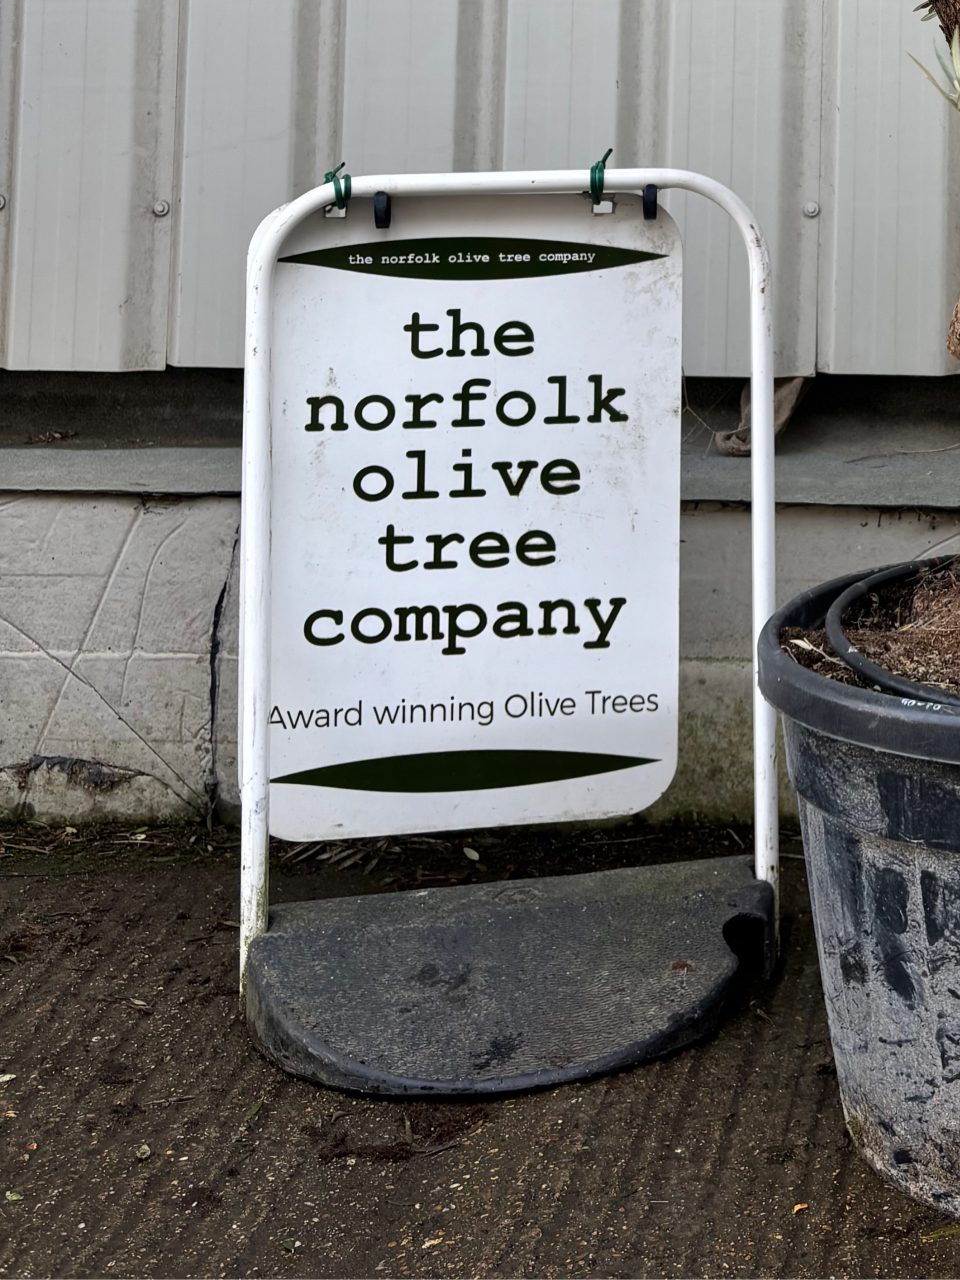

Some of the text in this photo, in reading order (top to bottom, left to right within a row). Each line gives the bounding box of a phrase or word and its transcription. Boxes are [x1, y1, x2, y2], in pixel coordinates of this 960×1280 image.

[348, 251, 596, 265] the norfolk olive tree company
[404, 308, 535, 359] the
[304, 374, 629, 432] norfolk
[352, 448, 581, 502] olive
[377, 524, 556, 572] tree
[303, 596, 627, 656] company
[268, 689, 659, 730] Award winning Olive Trees
